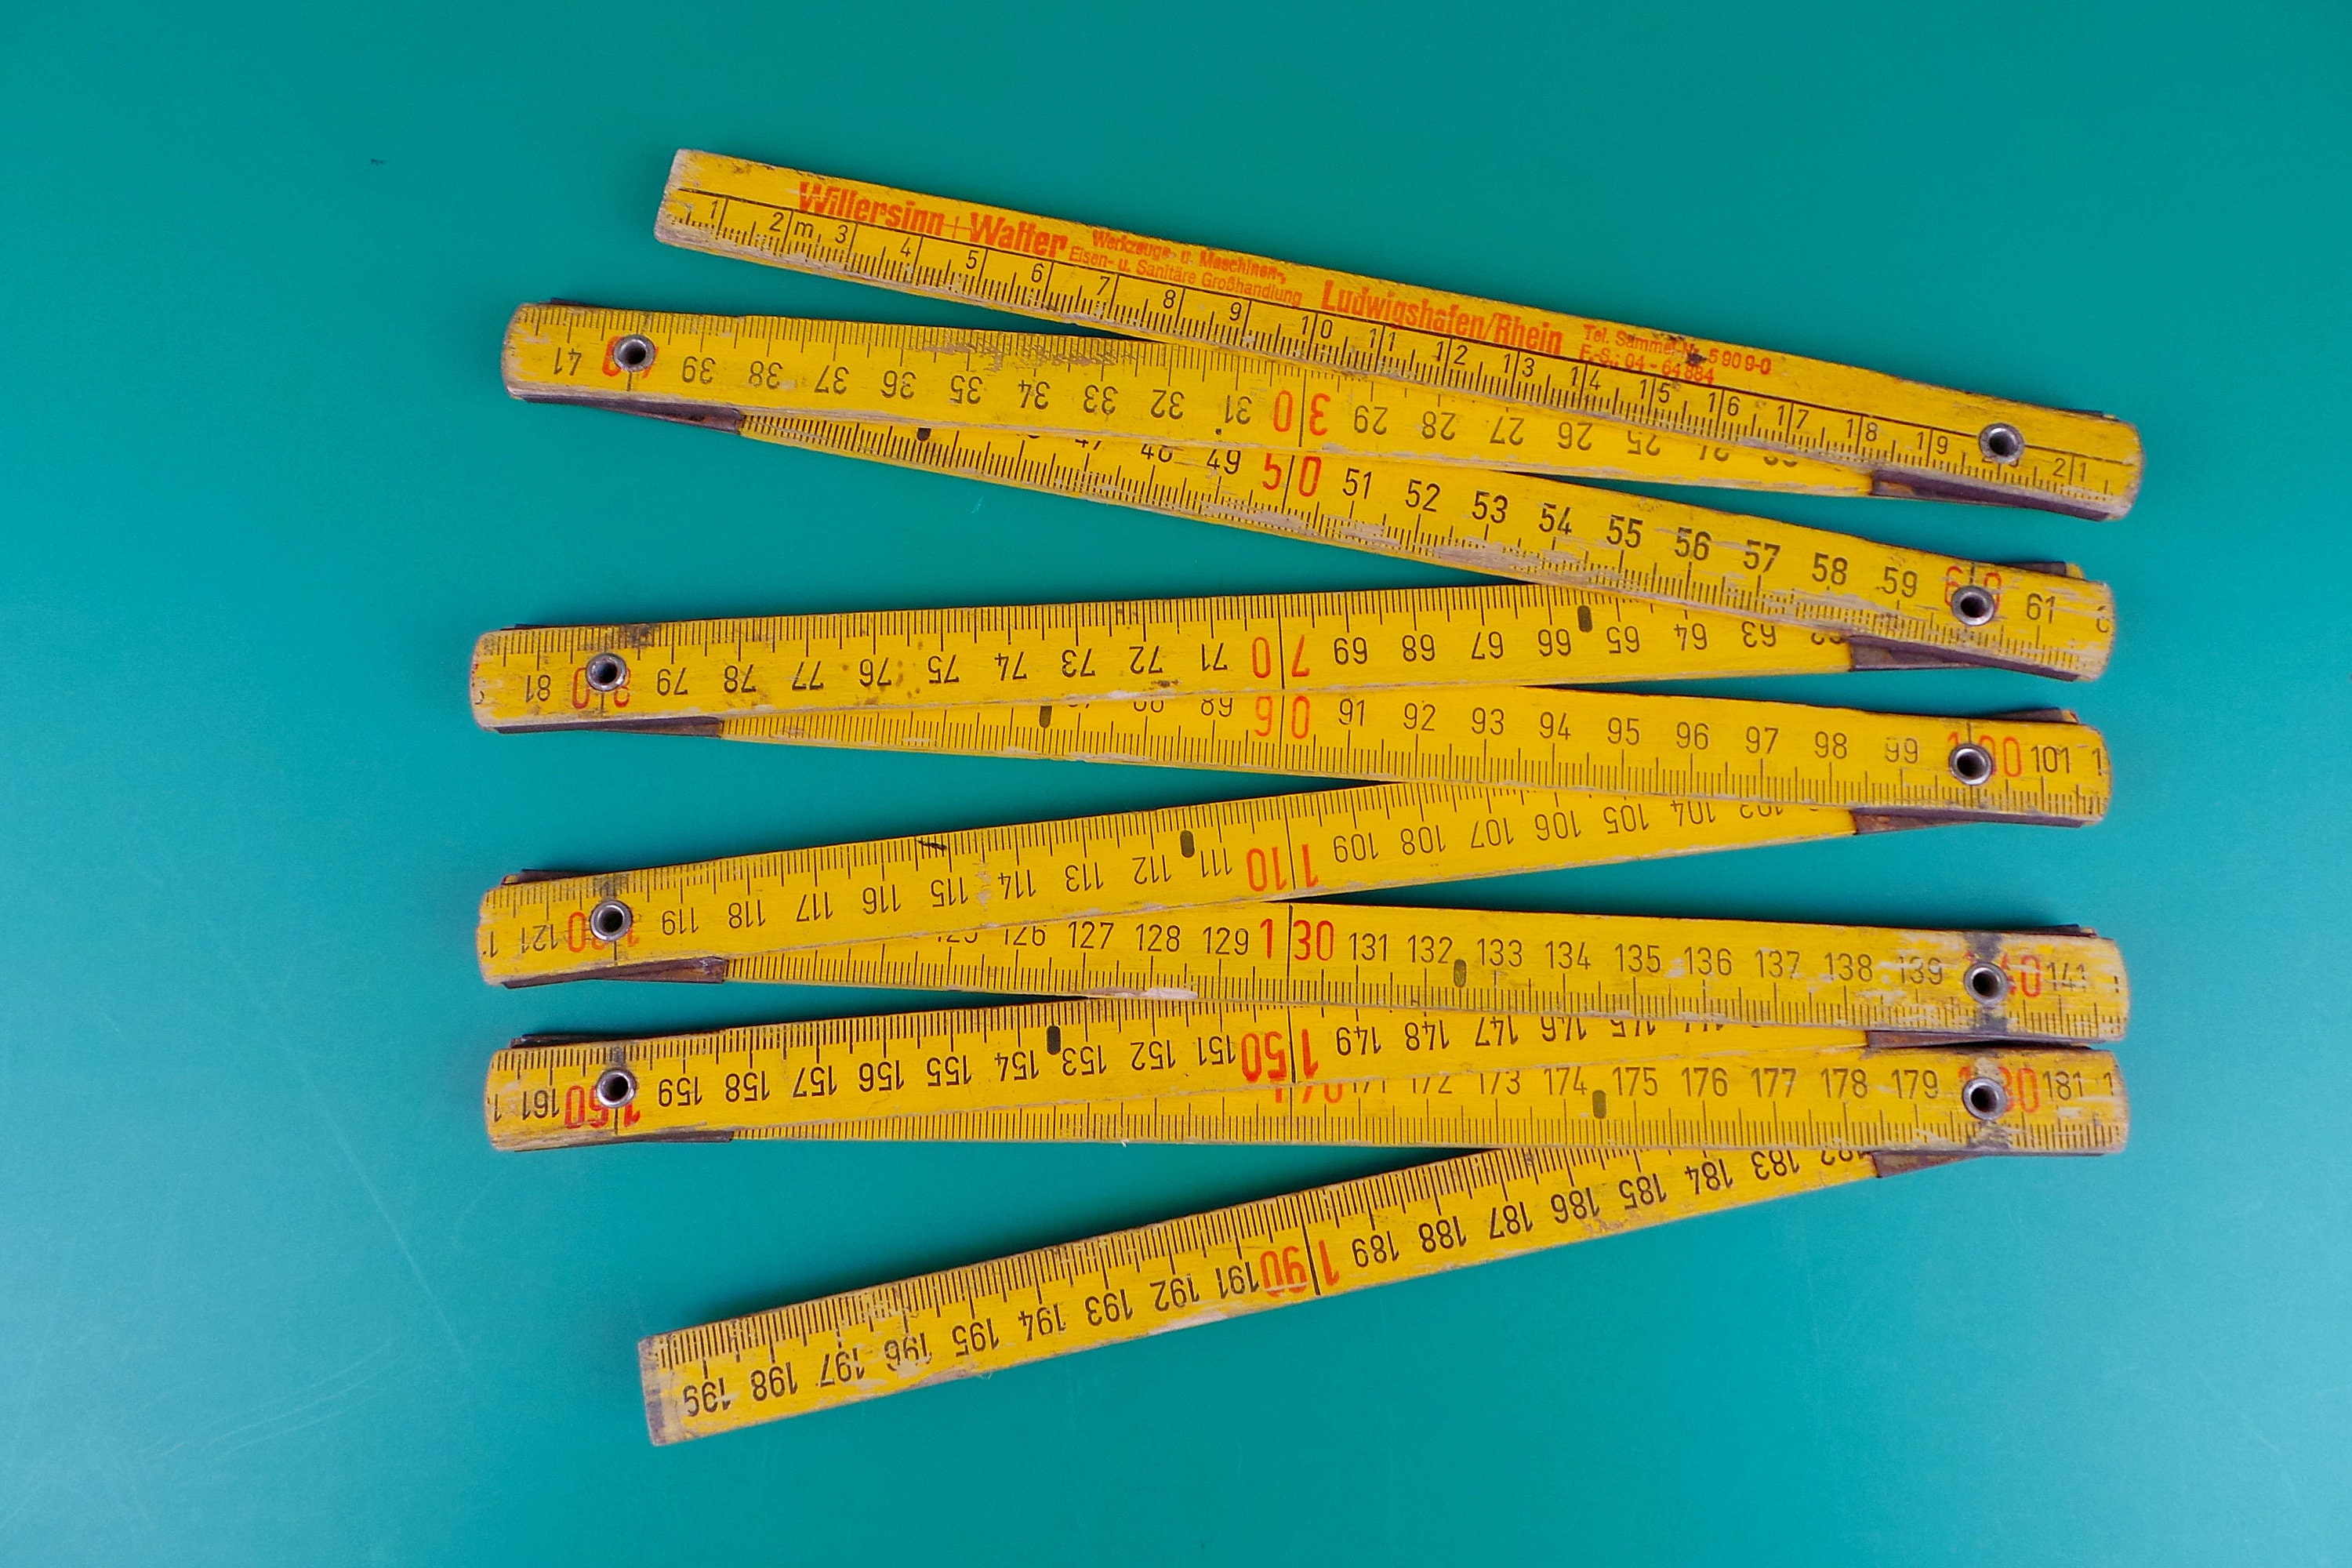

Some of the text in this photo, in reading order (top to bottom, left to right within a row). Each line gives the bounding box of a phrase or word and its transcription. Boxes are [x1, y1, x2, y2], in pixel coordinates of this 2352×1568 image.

[800, 181, 945, 236] Willersinn
[1069, 245, 1303, 309] Eisen- u. Sanitäre Großhandlung
[1321, 280, 1563, 354] Ludwigshafen/Rhein
[710, 201, 2087, 482] 1 2 m 3 4 5 6 7 8 9 10 11 12 13 14 15 16 17 18 19 21
[1584, 324, 1609, 343] Tel.
[554, 347, 582, 376] 41
[681, 356, 716, 384] 39
[750, 361, 783, 389] 38
[815, 365, 850, 394] 37
[880, 370, 916, 399] 36
[949, 375, 983, 405] 35
[1018, 379, 1051, 410] 34
[1083, 384, 1119, 416] 33
[1150, 389, 1185, 419] 32
[1225, 395, 1253, 425] 31
[1272, 390, 1331, 436] 30
[1354, 405, 1388, 435] 29
[1422, 411, 1456, 440] 28
[1490, 416, 1525, 445] 27
[1557, 421, 1593, 451] 26
[1342, 467, 2056, 623] 51 52 53 54 55 56 57 58 59 61
[525, 622, 1708, 702] 64 65 66 67 68 69 70 71 72 73 74 75 76 77 78 79 81
[1339, 698, 1847, 759] 91 92 93 94 95 96 97 98
[521, 803, 1650, 954] 105 106 107 108 109 110 111 112 113 114 115 116 117 118 119 121
[1068, 918, 1873, 982] 127 128 129 130 131 132 133 134 135 136 137 138
[522, 1019, 1450, 1121] 148 149 150 151 152 153 154 155 156 157 158 159 161
[1612, 1067, 1659, 1096] 175
[1682, 1067, 1728, 1098] 176
[1751, 1068, 1798, 1098] 177
[1820, 1068, 1868, 1098] 178
[1892, 1069, 1939, 1098] 179
[750, 1158, 1733, 1402] 184 185 186 187 188 189 191 192 193 194 195 198
